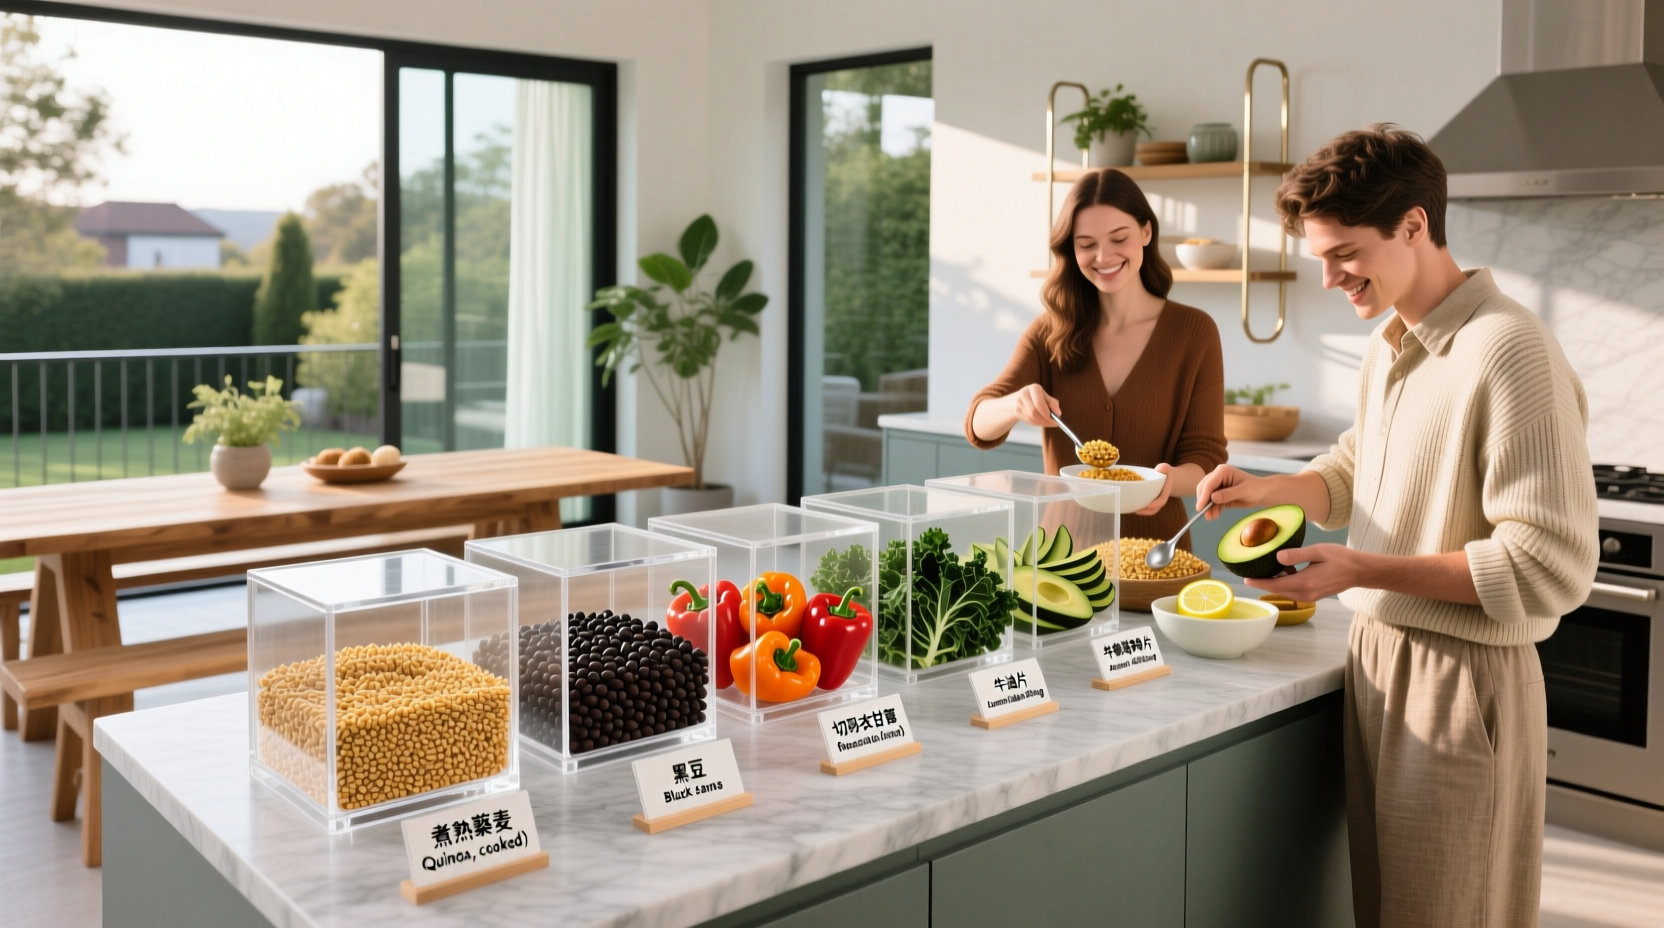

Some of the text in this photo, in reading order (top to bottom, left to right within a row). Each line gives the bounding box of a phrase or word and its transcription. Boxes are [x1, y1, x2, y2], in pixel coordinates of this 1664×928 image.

[672, 758, 707, 784] 黑豆
[422, 830, 528, 871] Quinoa, cooked)
